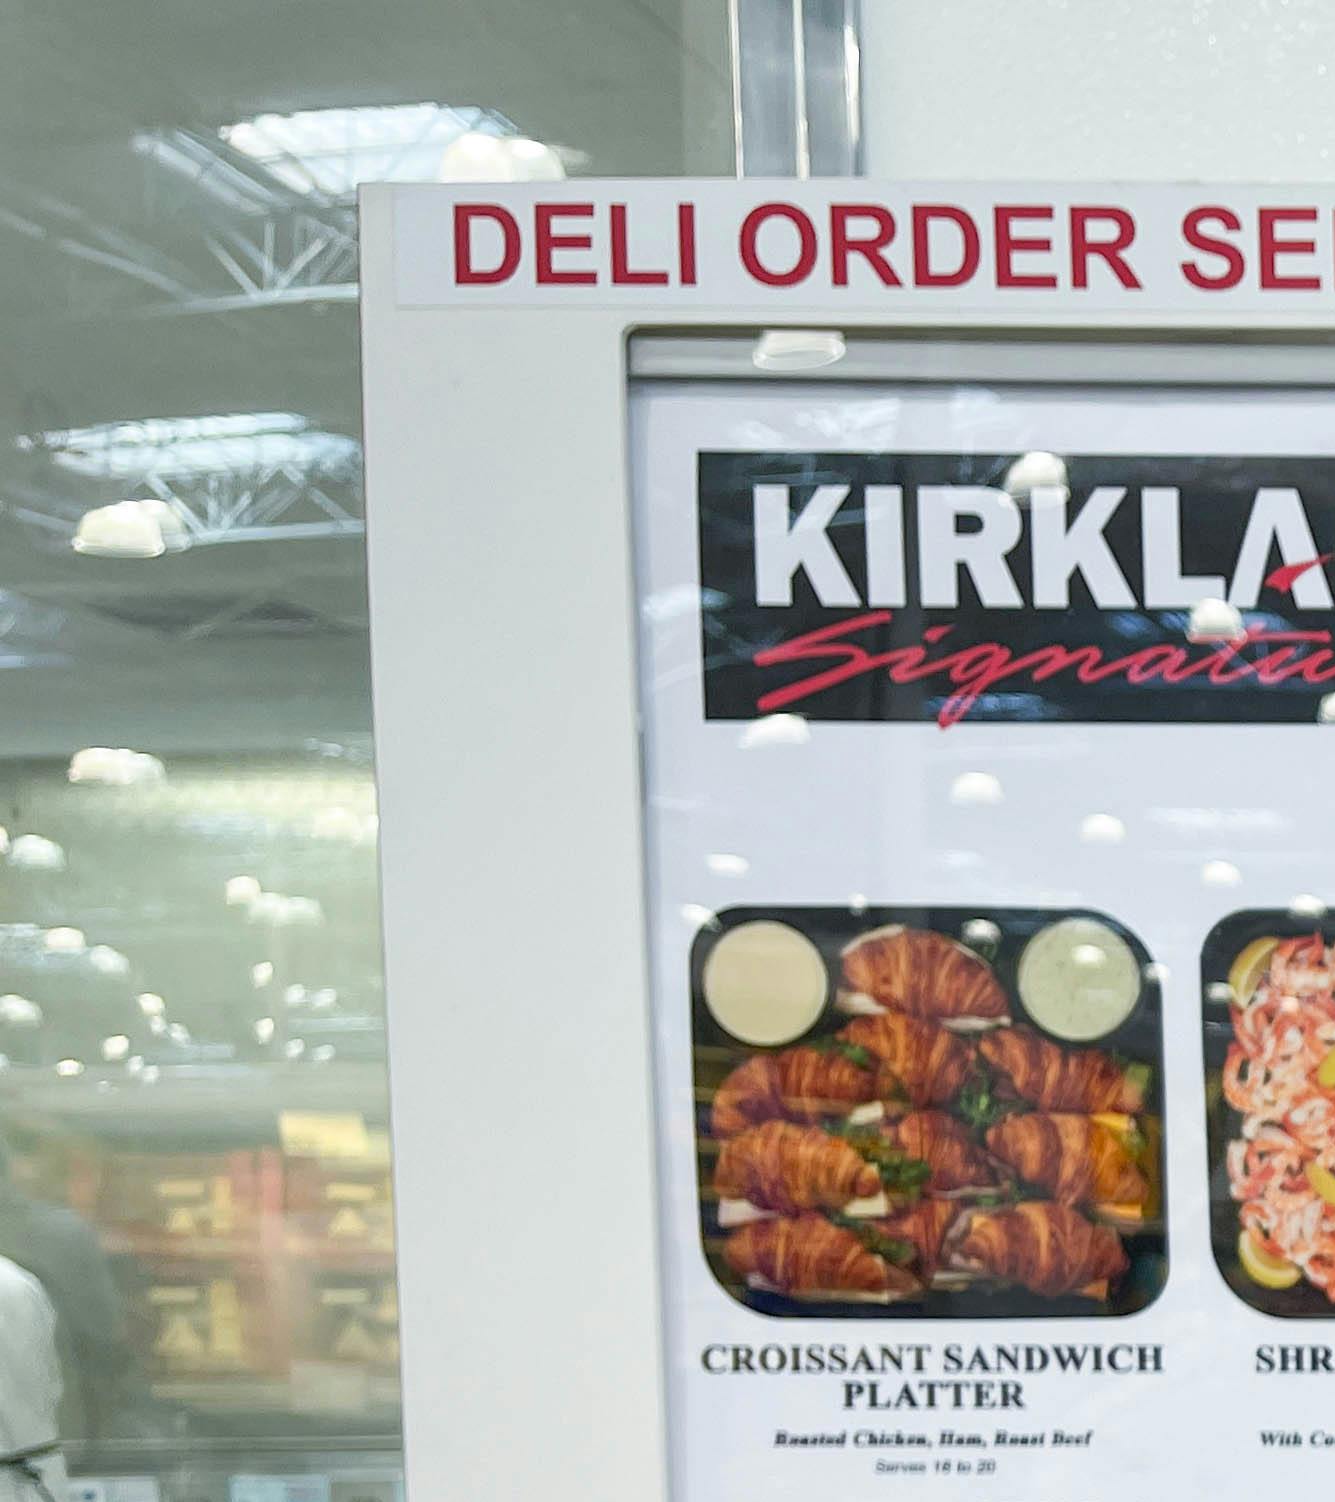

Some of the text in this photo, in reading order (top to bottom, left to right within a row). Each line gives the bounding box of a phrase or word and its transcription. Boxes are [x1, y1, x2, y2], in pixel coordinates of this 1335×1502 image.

[452, 204, 698, 286] DELI
[740, 203, 1142, 290] ORDER
[701, 1344, 1164, 1374] CROISSANT SANDWICH
[842, 1380, 1025, 1409] PLATTER
[1261, 1431, 1302, 1448] With
